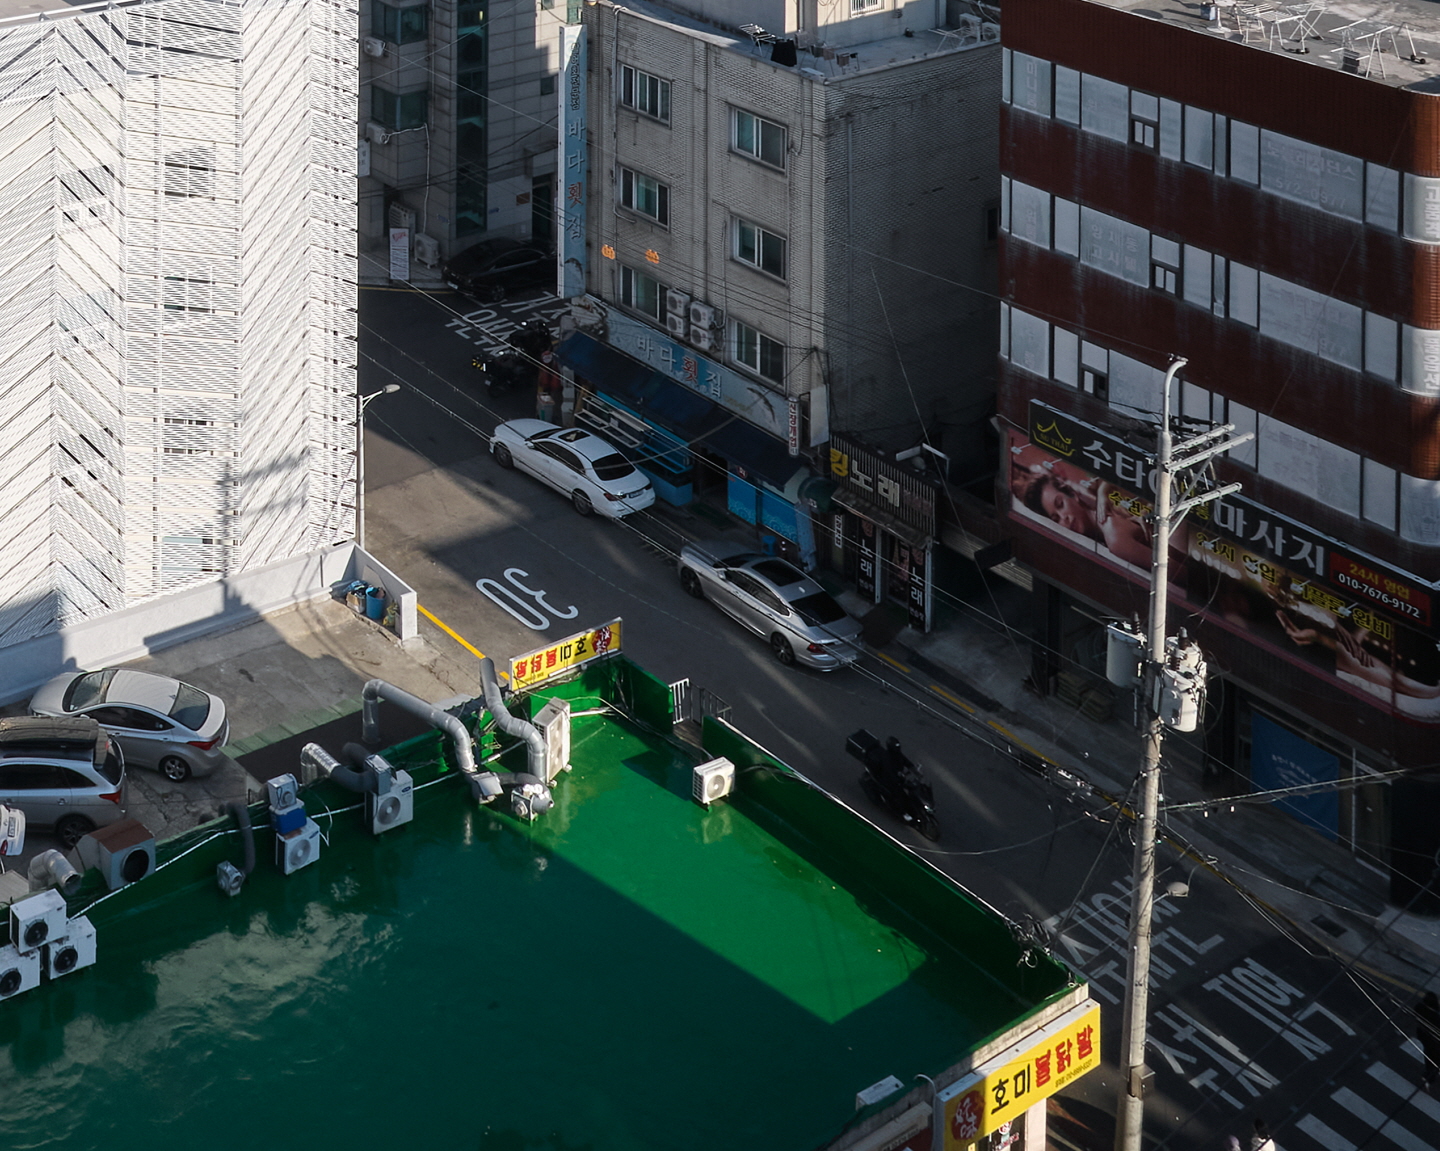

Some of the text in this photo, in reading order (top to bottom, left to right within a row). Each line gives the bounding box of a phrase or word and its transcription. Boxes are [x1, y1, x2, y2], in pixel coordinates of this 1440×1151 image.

[566, 117, 586, 241] 바다횟집
[637, 335, 722, 399] 바다횟집
[1050, 437, 1068, 451] THAI
[1213, 500, 1325, 577] 마사지
[1338, 572, 1420, 619] 010-7676-9172
[1349, 563, 1410, 600] 24시 영업
[1352, 607, 1391, 640] 완비
